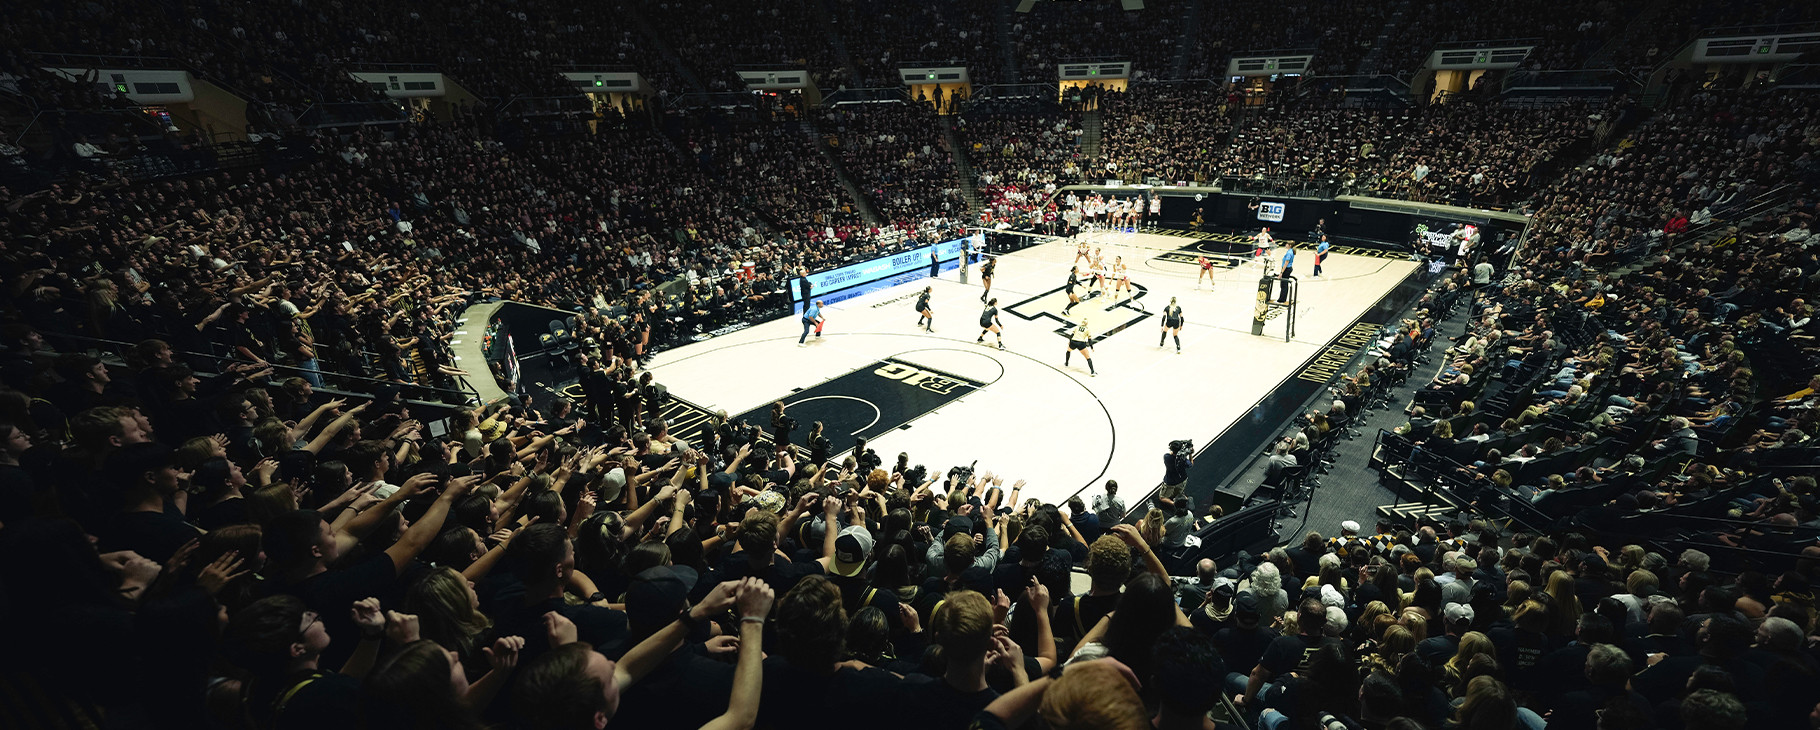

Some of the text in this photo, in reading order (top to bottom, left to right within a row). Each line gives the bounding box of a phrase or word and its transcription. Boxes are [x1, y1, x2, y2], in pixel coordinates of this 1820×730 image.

[892, 254, 912, 267] BOILER
[912, 252, 922, 261] UP!
[862, 263, 890, 275] WABASH
[820, 280, 829, 288] BIG
[829, 275, 846, 286] CAREER
[846, 272, 861, 281] IMPACT
[1297, 322, 1384, 384] MACKEY ARENA
